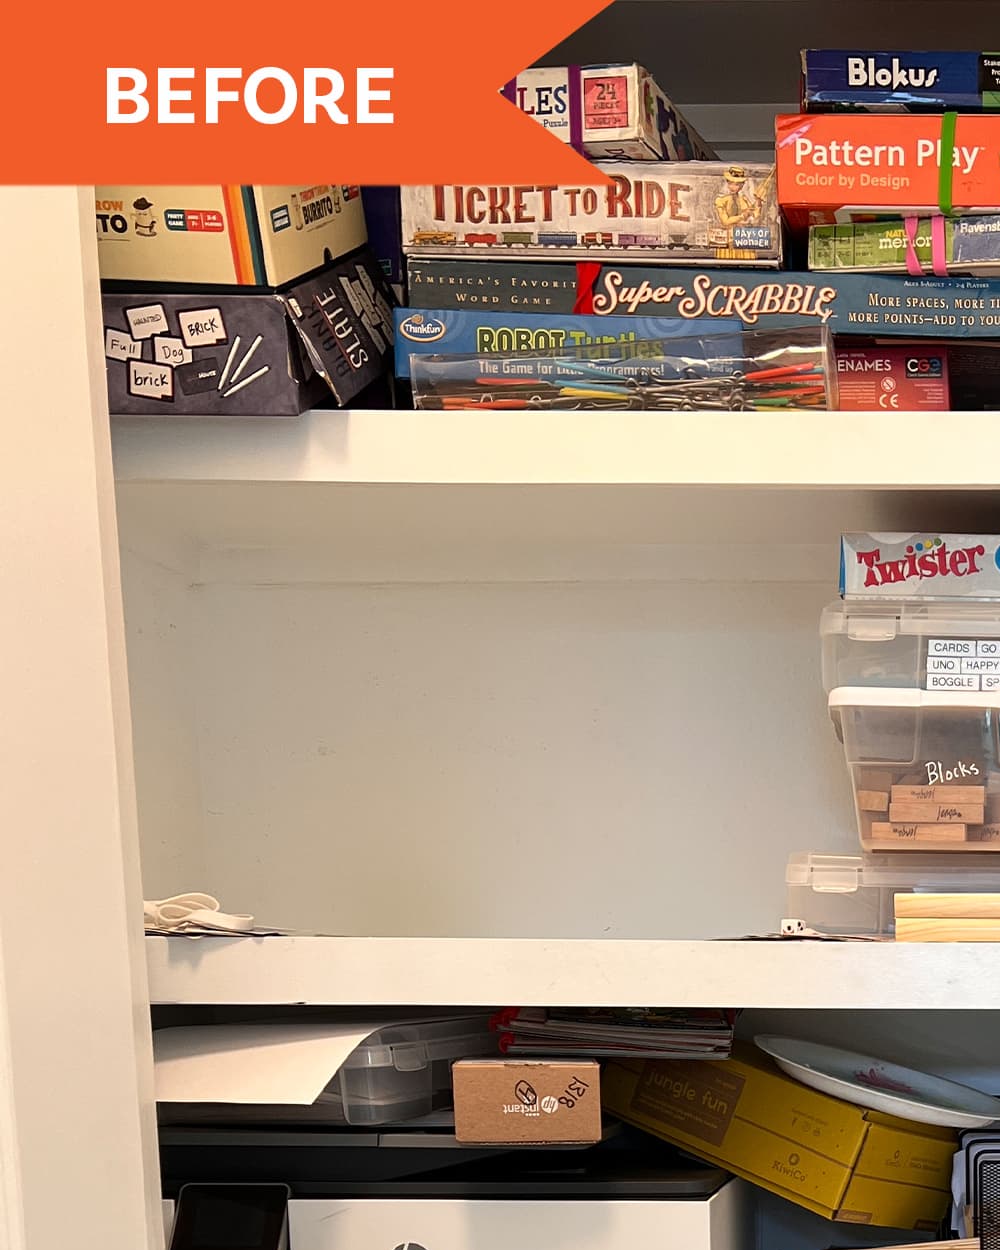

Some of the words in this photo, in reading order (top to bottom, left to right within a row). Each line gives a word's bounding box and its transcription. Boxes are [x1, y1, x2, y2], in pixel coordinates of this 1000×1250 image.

[983, 59, 1000, 67] Stake
[847, 57, 938, 89] Blokus
[594, 83, 617, 101] 24
[795, 138, 905, 167] Pattern
[795, 173, 833, 187] Color
[840, 173, 856, 190] by
[860, 173, 910, 191] Design
[432, 184, 558, 225] TICKET
[563, 188, 598, 216] TO
[605, 174, 692, 223] RIDE
[302, 196, 333, 225] BURRITO
[414, 273, 500, 287] AMERICA'S
[510, 276, 577, 289] FAVORIT
[455, 293, 500, 304] WORD
[510, 294, 552, 305] GAME
[592, 270, 686, 316] Super
[677, 273, 838, 324] SCRABBLE
[868, 293, 901, 307] MORE
[906, 297, 949, 310] SPACES,
[954, 298, 985, 309] MORE
[187, 318, 218, 337] BRICK
[316, 286, 369, 369] SLATE
[848, 312, 879, 323] MORE
[961, 315, 975, 326] TO
[110, 338, 136, 354] Full
[477, 327, 566, 358] ROBOT
[569, 330, 665, 359] Turtles
[162, 344, 185, 363] Dog
[478, 361, 498, 374] The
[502, 361, 533, 375] Game
[537, 361, 552, 374] for
[837, 359, 892, 372] ENAMES
[133, 370, 168, 387] brick
[856, 543, 985, 589] Twister
[934, 642, 970, 653] CARDS
[980, 643, 997, 653] GO
[933, 660, 955, 671] UNO
[966, 661, 999, 671] HAPPY
[932, 677, 974, 688] BOGGLE
[924, 760, 980, 786] Blocks
[648, 1071, 696, 1100] jungle
[702, 1089, 728, 1115] fun
[771, 1160, 808, 1183] KiwiCo
